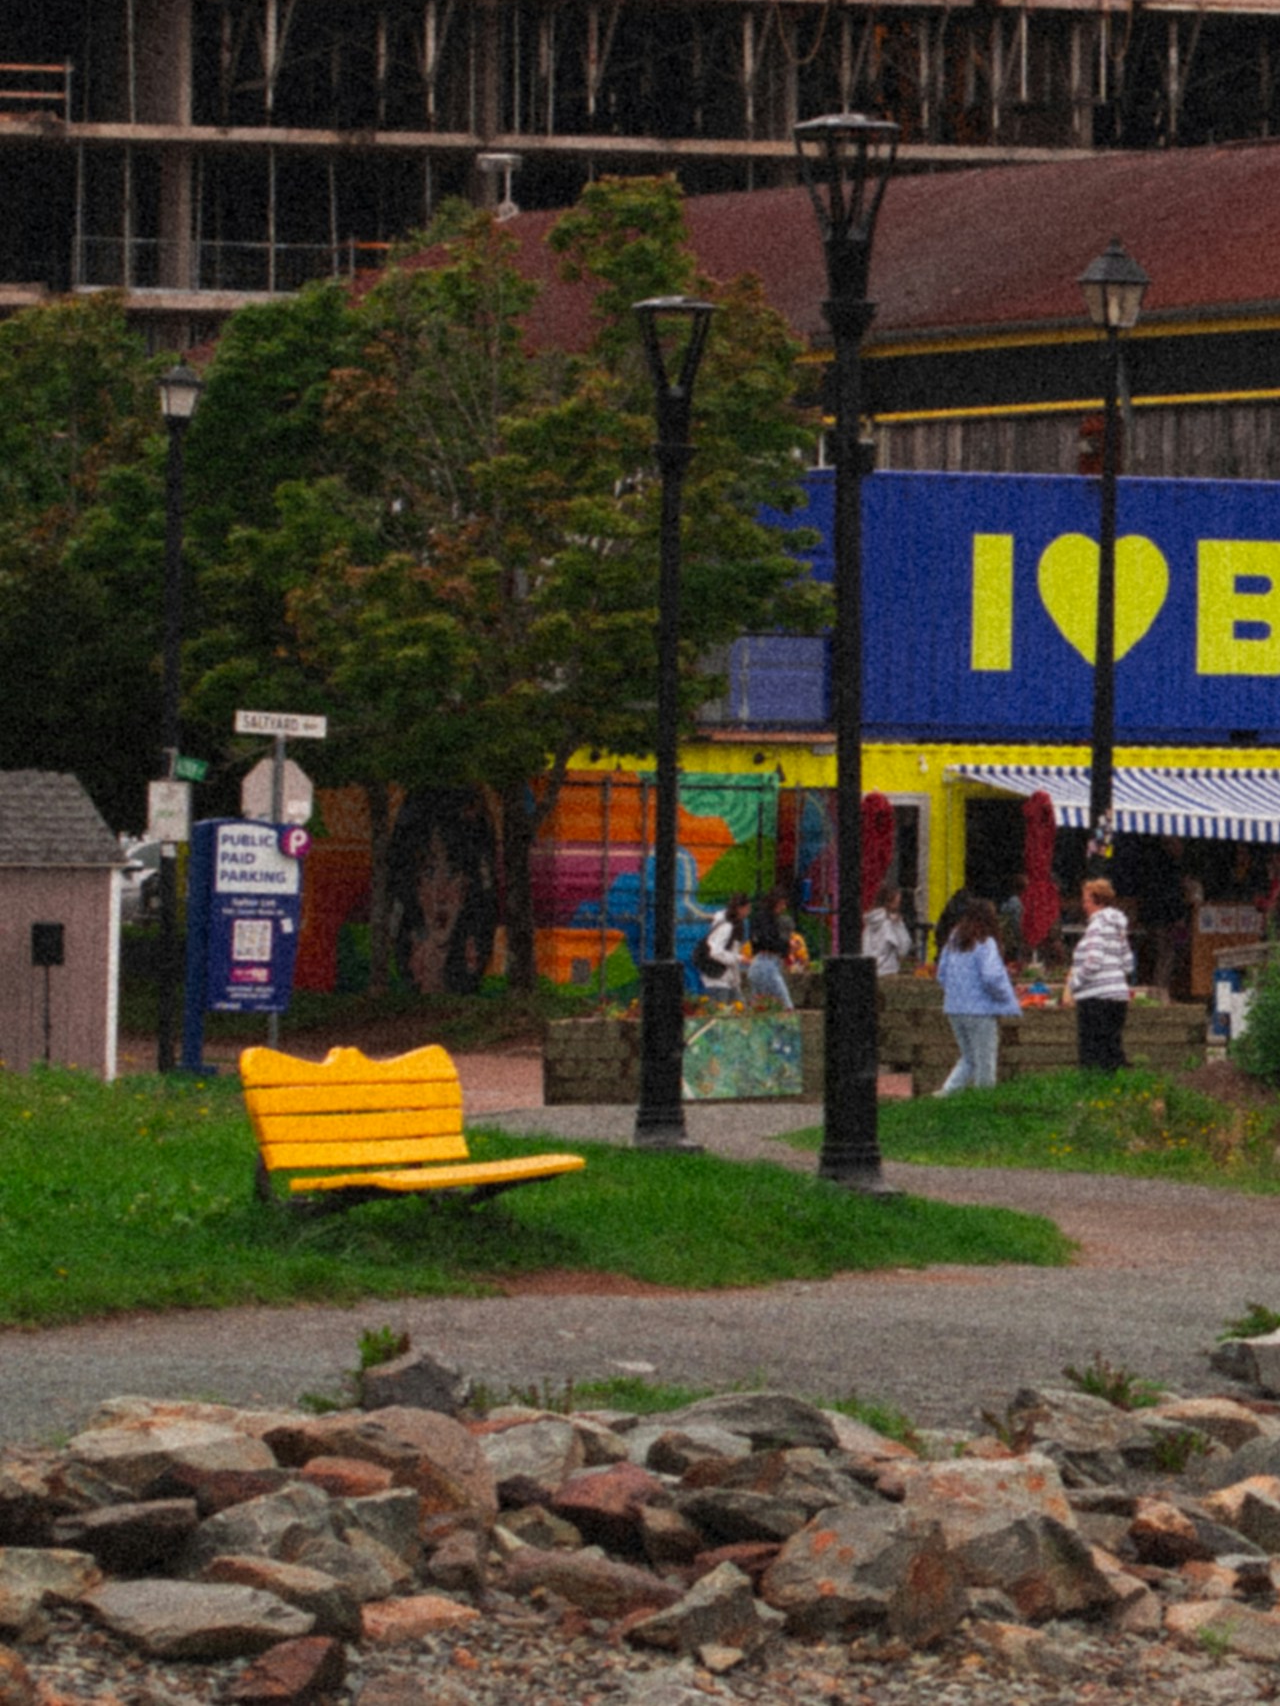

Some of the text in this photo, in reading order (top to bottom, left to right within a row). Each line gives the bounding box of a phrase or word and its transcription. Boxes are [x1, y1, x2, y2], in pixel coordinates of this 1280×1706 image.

[970, 533, 1013, 672] I
[243, 715, 299, 731] SALTYARD
[221, 834, 275, 847] PUBLIC
[221, 852, 255, 864] PAID
[220, 870, 286, 883] PARKING
